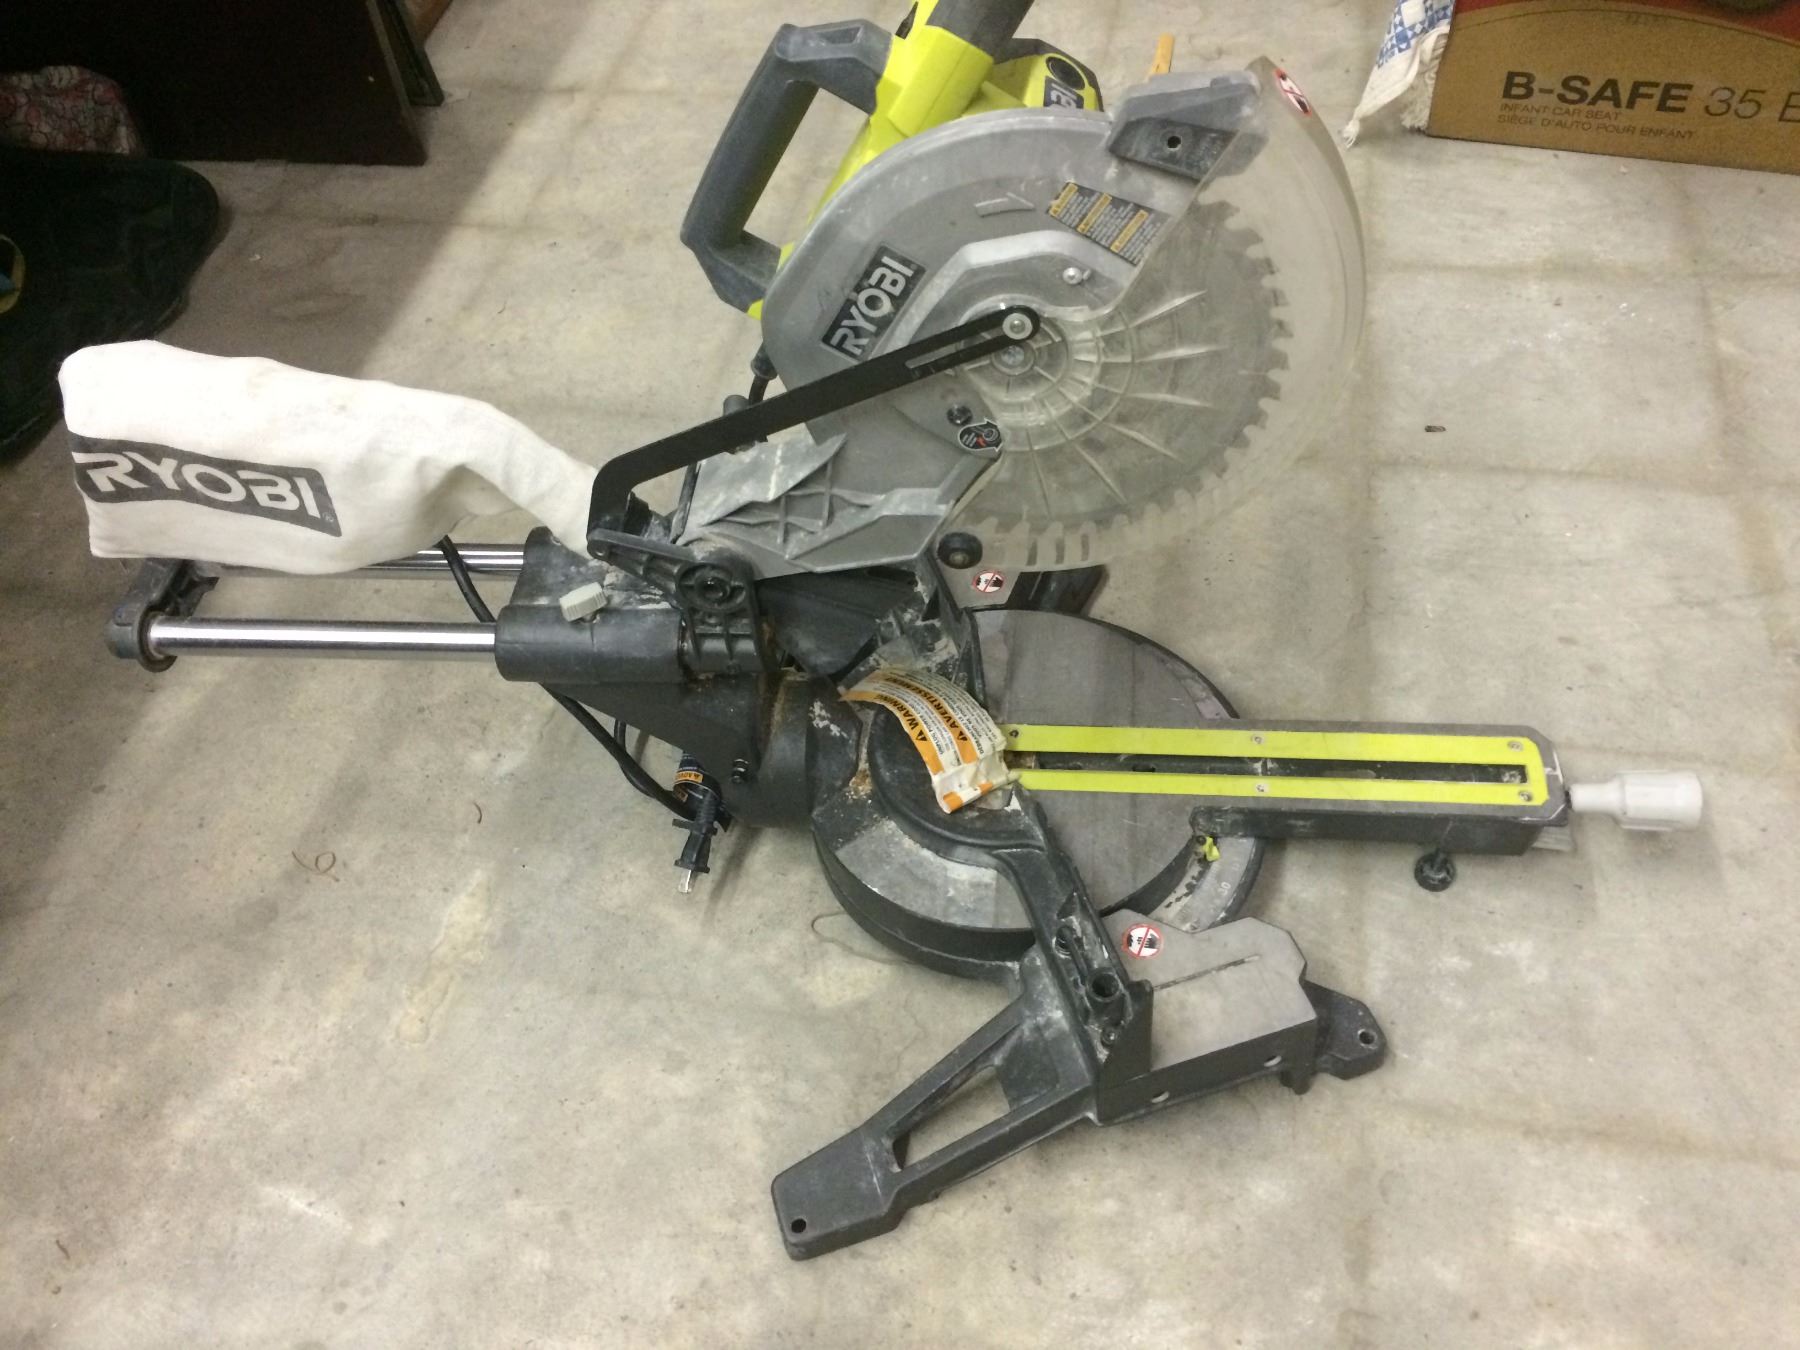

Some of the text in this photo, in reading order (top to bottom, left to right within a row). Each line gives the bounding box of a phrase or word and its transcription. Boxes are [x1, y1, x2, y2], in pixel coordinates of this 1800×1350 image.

[1501, 103, 1622, 121] INFANT CAR SEAT
[1502, 71, 1694, 113] B-SAFE
[1703, 86, 1766, 120] 35
[1596, 123, 1636, 135] POUR
[1640, 127, 1696, 140] ENFANT
[830, 256, 915, 356] RYOBI
[71, 451, 321, 519] RYOBI
[874, 694, 918, 730] WARNING
